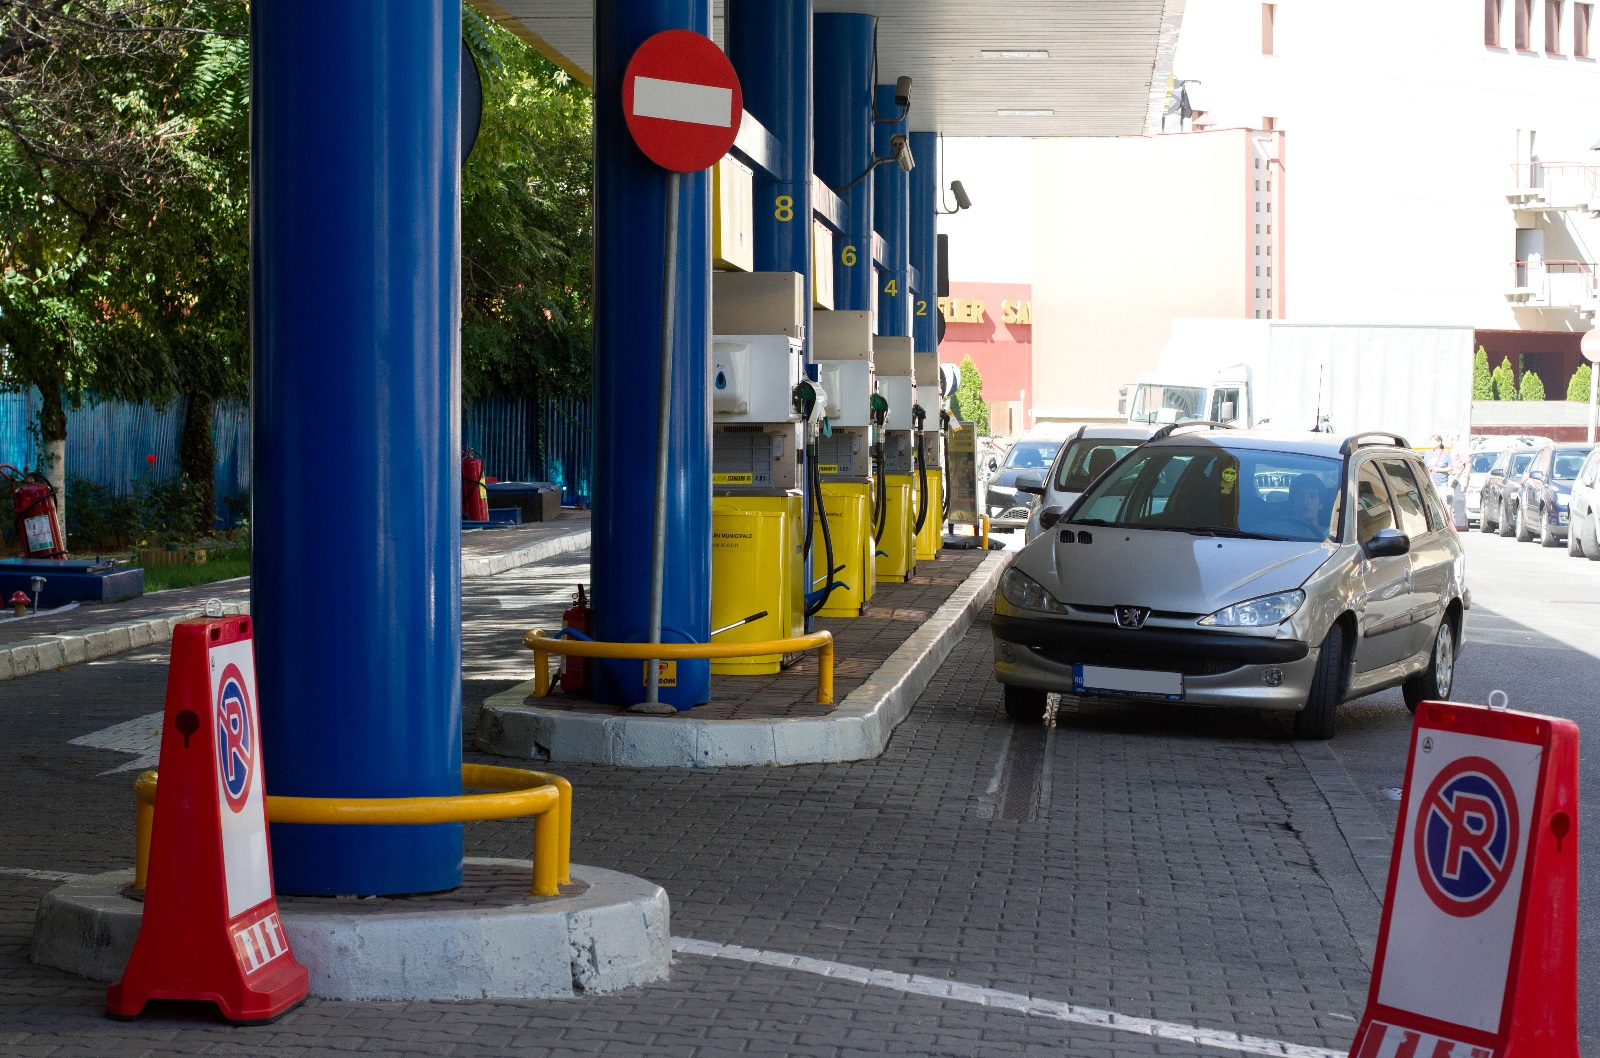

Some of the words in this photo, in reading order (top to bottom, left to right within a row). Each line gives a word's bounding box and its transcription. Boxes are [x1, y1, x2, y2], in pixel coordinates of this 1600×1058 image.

[775, 195, 794, 222] 8
[841, 245, 857, 267] 6
[884, 280, 898, 297] 4
[916, 300, 927, 316] 2
